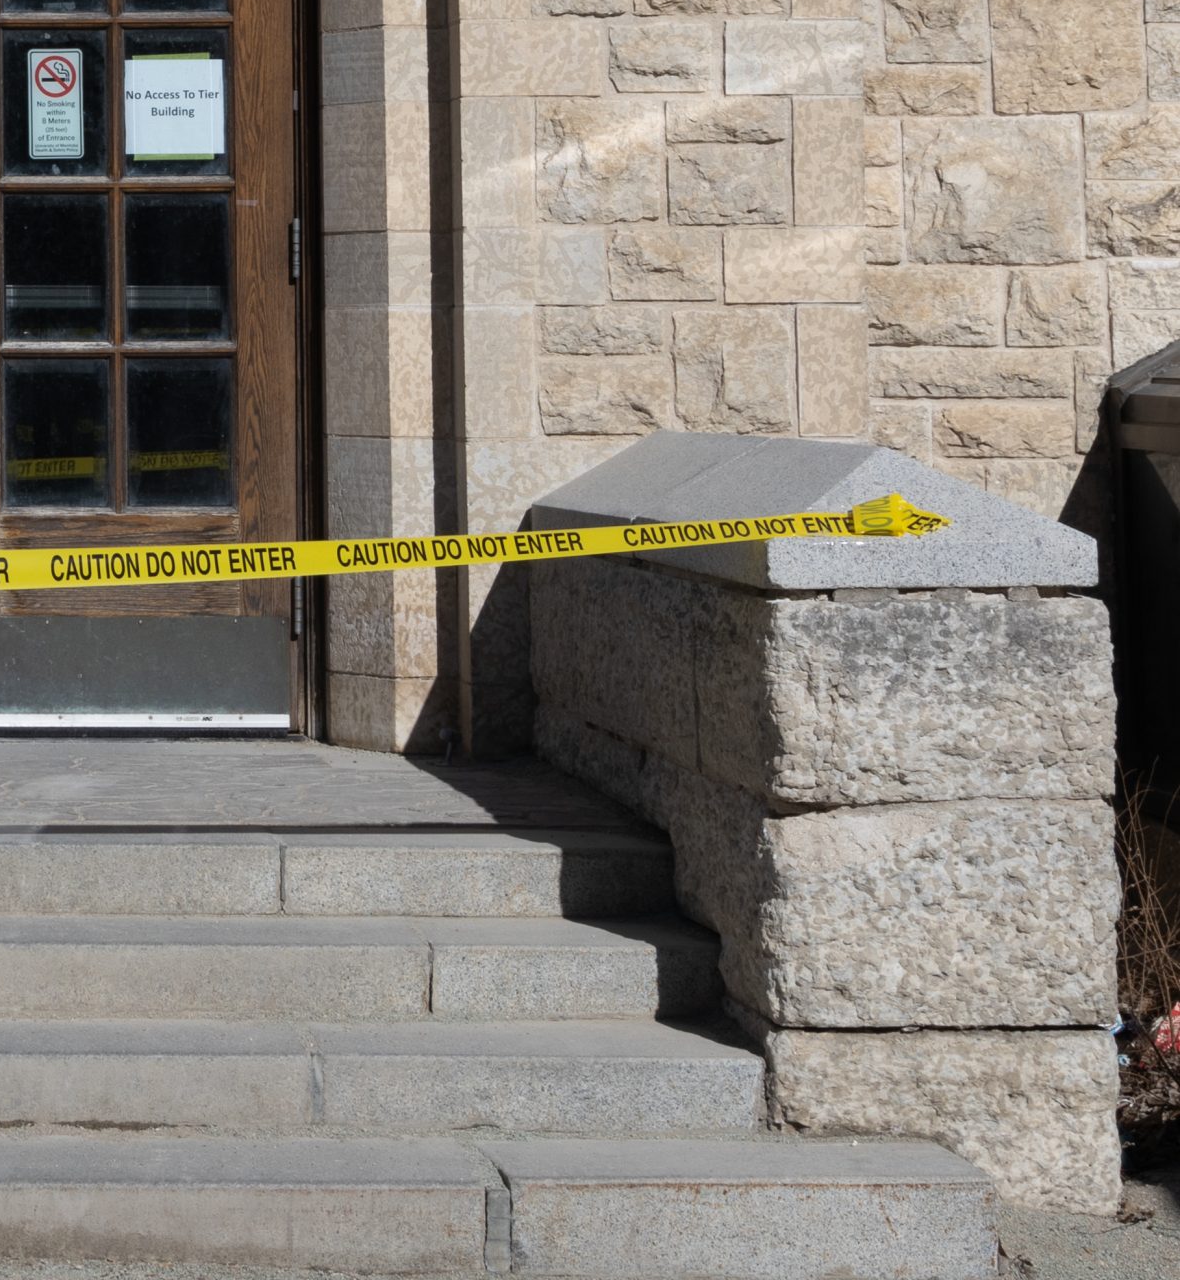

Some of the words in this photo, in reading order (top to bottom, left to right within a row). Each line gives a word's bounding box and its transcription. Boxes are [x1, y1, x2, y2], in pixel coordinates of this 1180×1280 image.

[47, 100, 76, 108] Smoking
[125, 90, 141, 100] No
[144, 90, 180, 100] Access
[182, 89, 196, 99] To
[198, 89, 220, 99] Tier
[151, 107, 195, 118] Building
[623, 524, 716, 547] CAUTION
[719, 520, 750, 539] DO
[755, 518, 797, 536] NOT
[801, 516, 855, 534] ENTE
[336, 540, 428, 567] CAUTION
[432, 538, 462, 561] DO
[466, 536, 508, 559] NOT
[513, 532, 584, 555] ENTER
[50, 552, 140, 581] CAUTION
[145, 551, 176, 577] DO
[181, 549, 222, 576] NOT
[228, 546, 297, 574] ENTER
